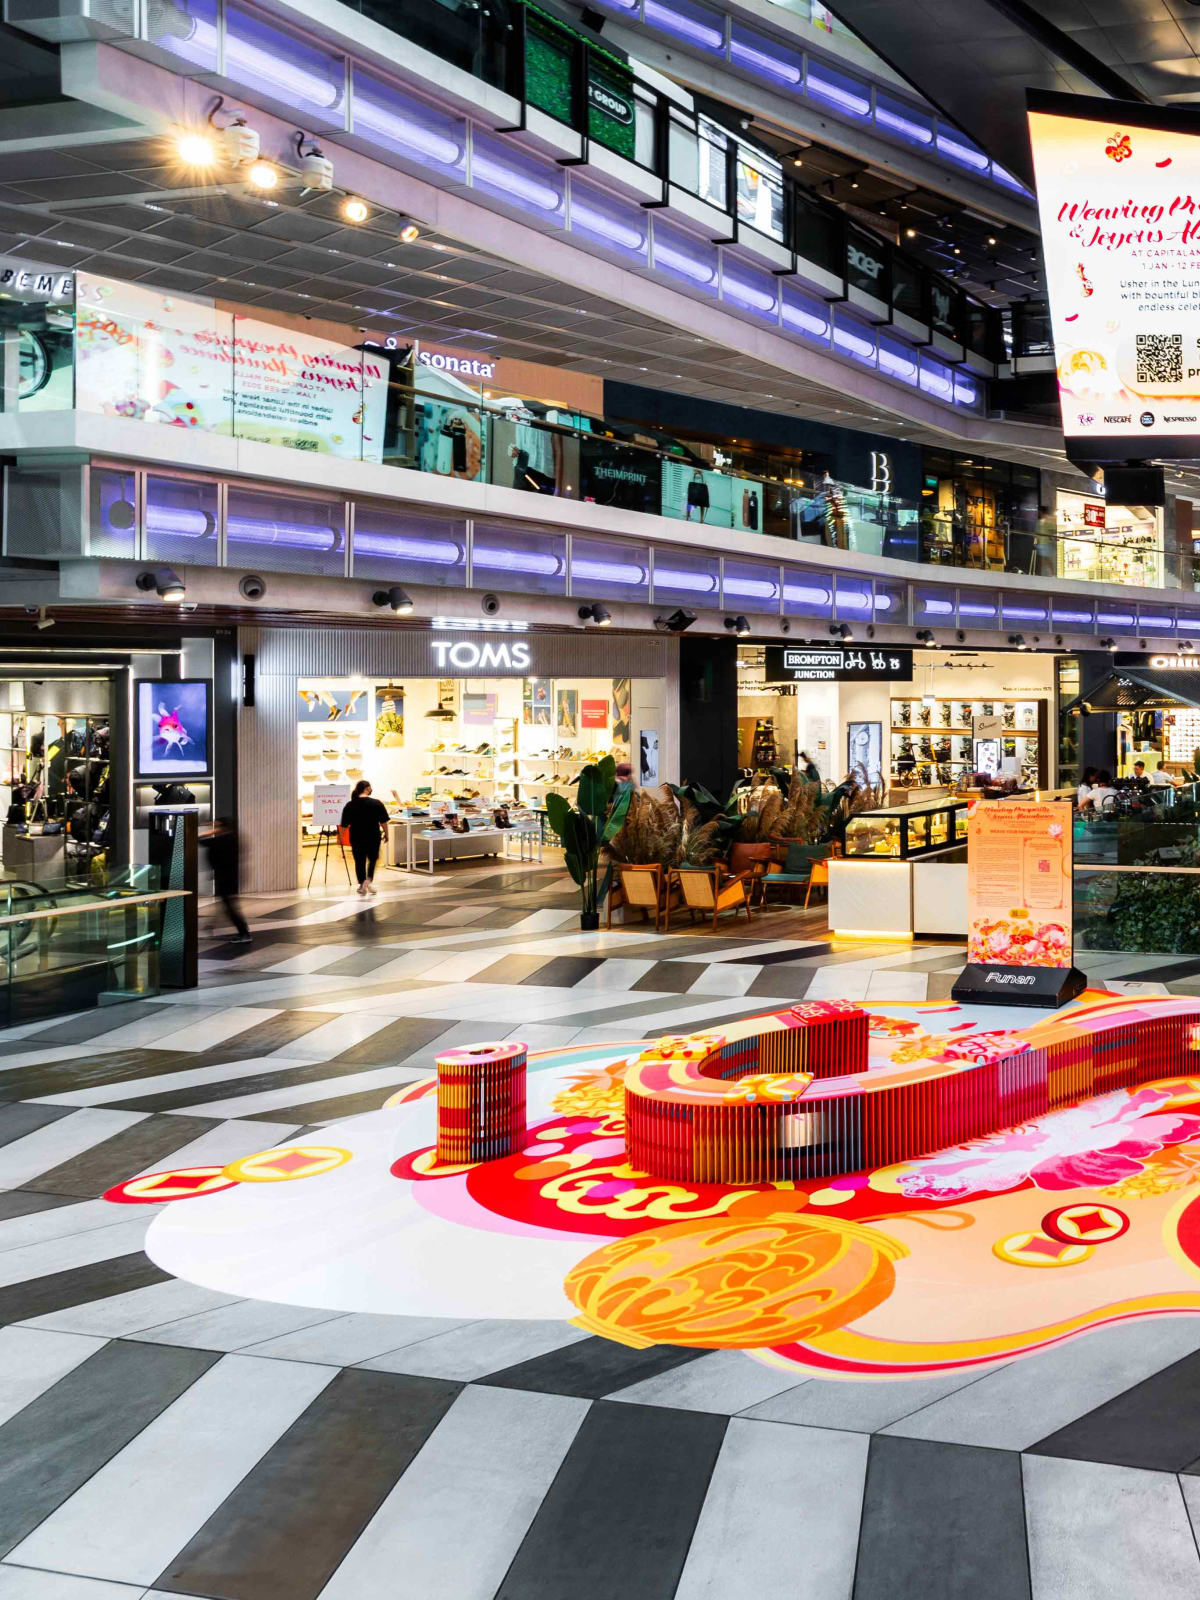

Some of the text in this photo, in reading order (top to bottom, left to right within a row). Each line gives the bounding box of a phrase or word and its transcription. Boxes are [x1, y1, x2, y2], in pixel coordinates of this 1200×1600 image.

[594, 90, 628, 115] GROUP
[1057, 200, 1164, 224] Weaving
[1082, 226, 1163, 250] Joyous
[1131, 250, 1142, 258] AT
[1149, 262, 1168, 270] JAN
[1177, 262, 1187, 270] 12
[1119, 279, 1148, 289] Usher
[1151, 279, 1160, 288] in
[1163, 279, 1179, 288] the
[1120, 291, 1141, 300] with
[1144, 290, 1189, 300] bountiful
[1138, 302, 1175, 312] endless
[431, 642, 531, 668] TOMS
[788, 655, 840, 665] BROMPTON
[794, 670, 835, 679] JUNCTION
[985, 972, 1036, 985] Funan
